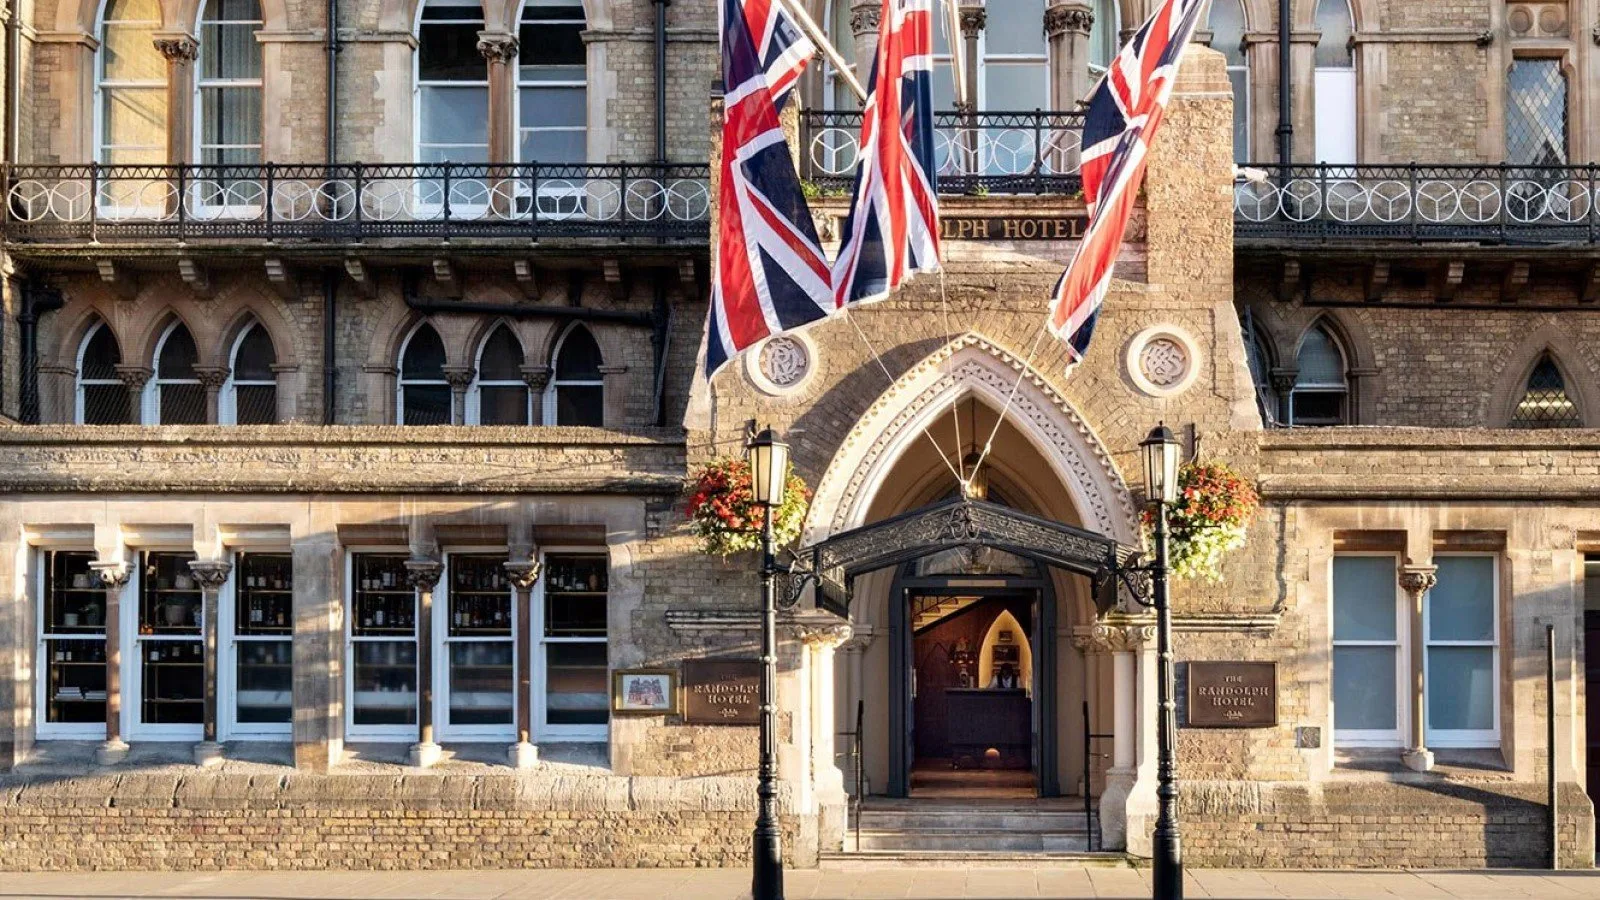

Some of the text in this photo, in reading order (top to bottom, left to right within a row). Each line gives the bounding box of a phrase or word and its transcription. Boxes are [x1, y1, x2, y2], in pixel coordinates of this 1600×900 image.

[938, 219, 1084, 238] LPH HOTEL
[1199, 686, 1269, 696] RANDOLPH
[708, 694, 750, 704] HOTEL
[1213, 697, 1254, 706] HOTEL
